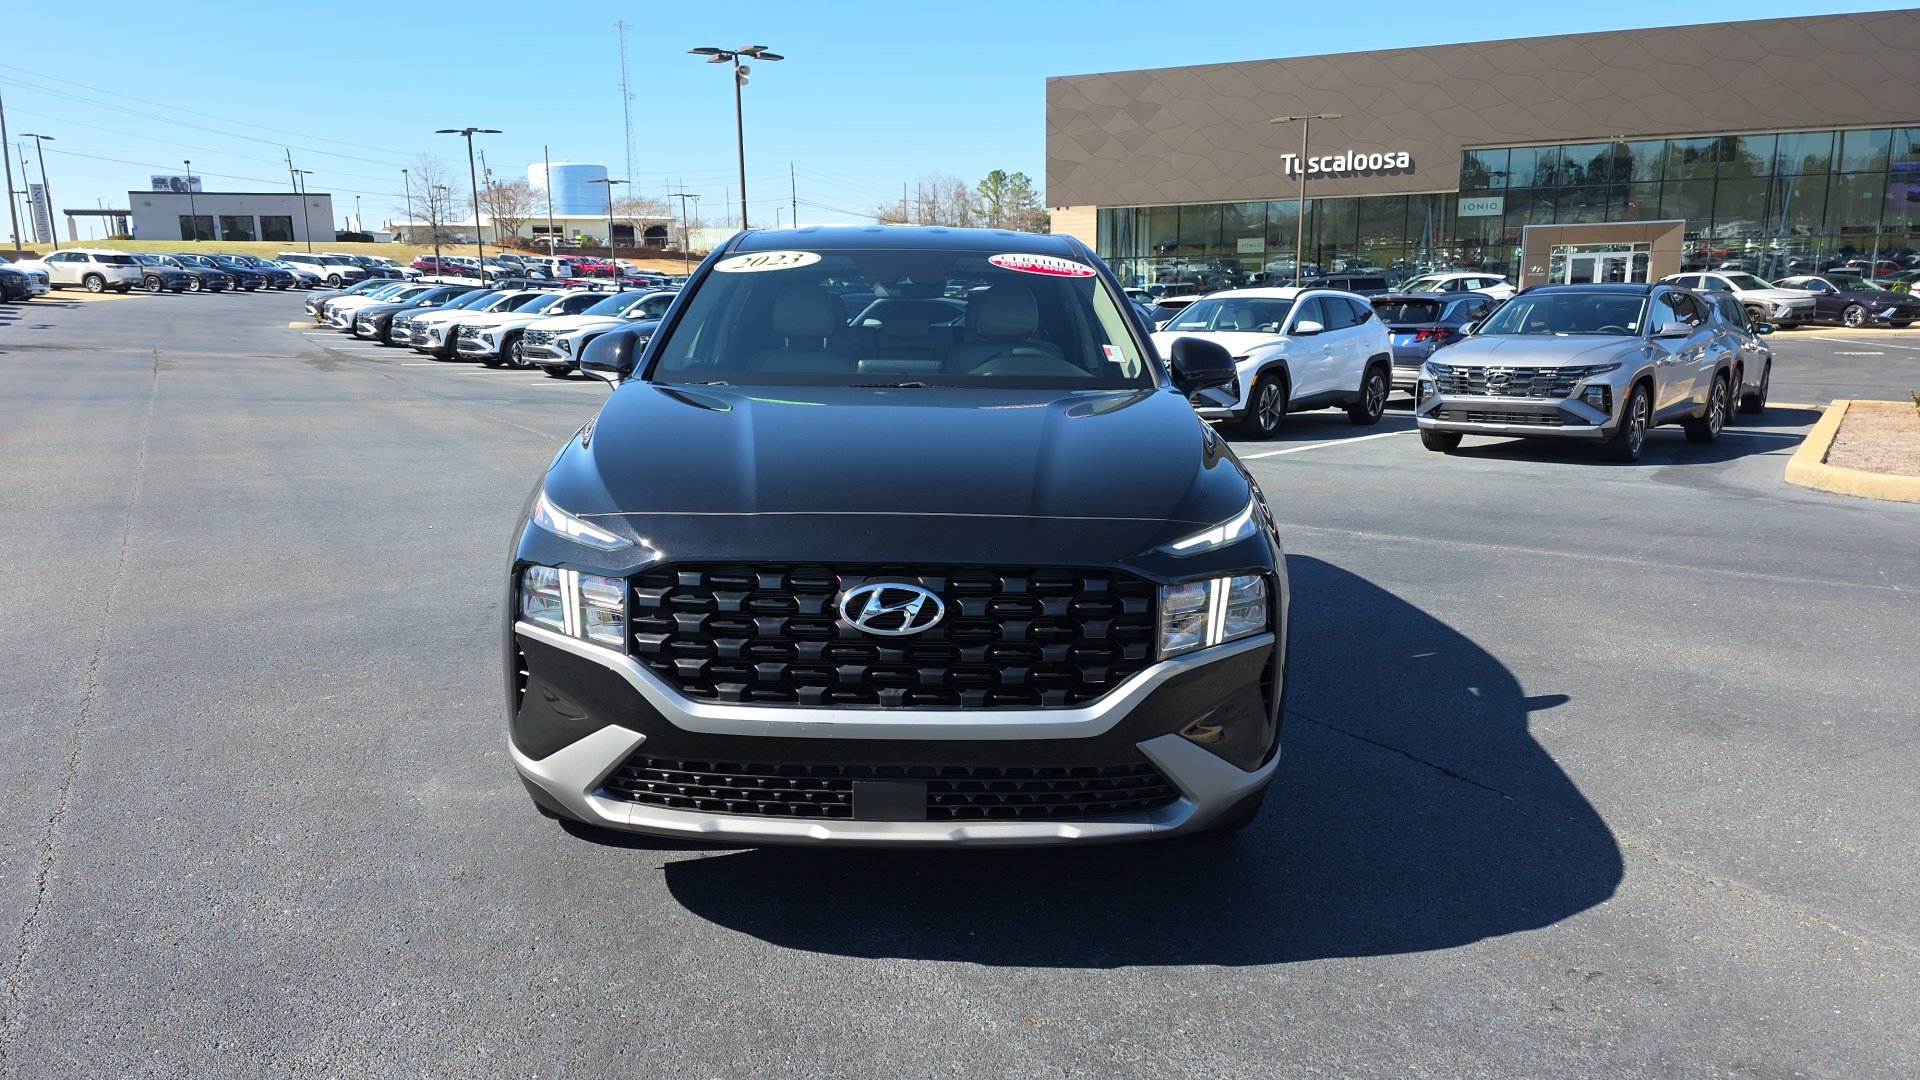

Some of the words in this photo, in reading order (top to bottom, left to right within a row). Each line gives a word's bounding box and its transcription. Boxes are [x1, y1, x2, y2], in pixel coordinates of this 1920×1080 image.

[1280, 150, 1409, 174] Tuscaloosa
[1463, 202, 1498, 211] IONIQ
[38, 204, 48, 238] Alabama
[731, 254, 804, 270] 2023
[1001, 260, 1032, 268] USED
